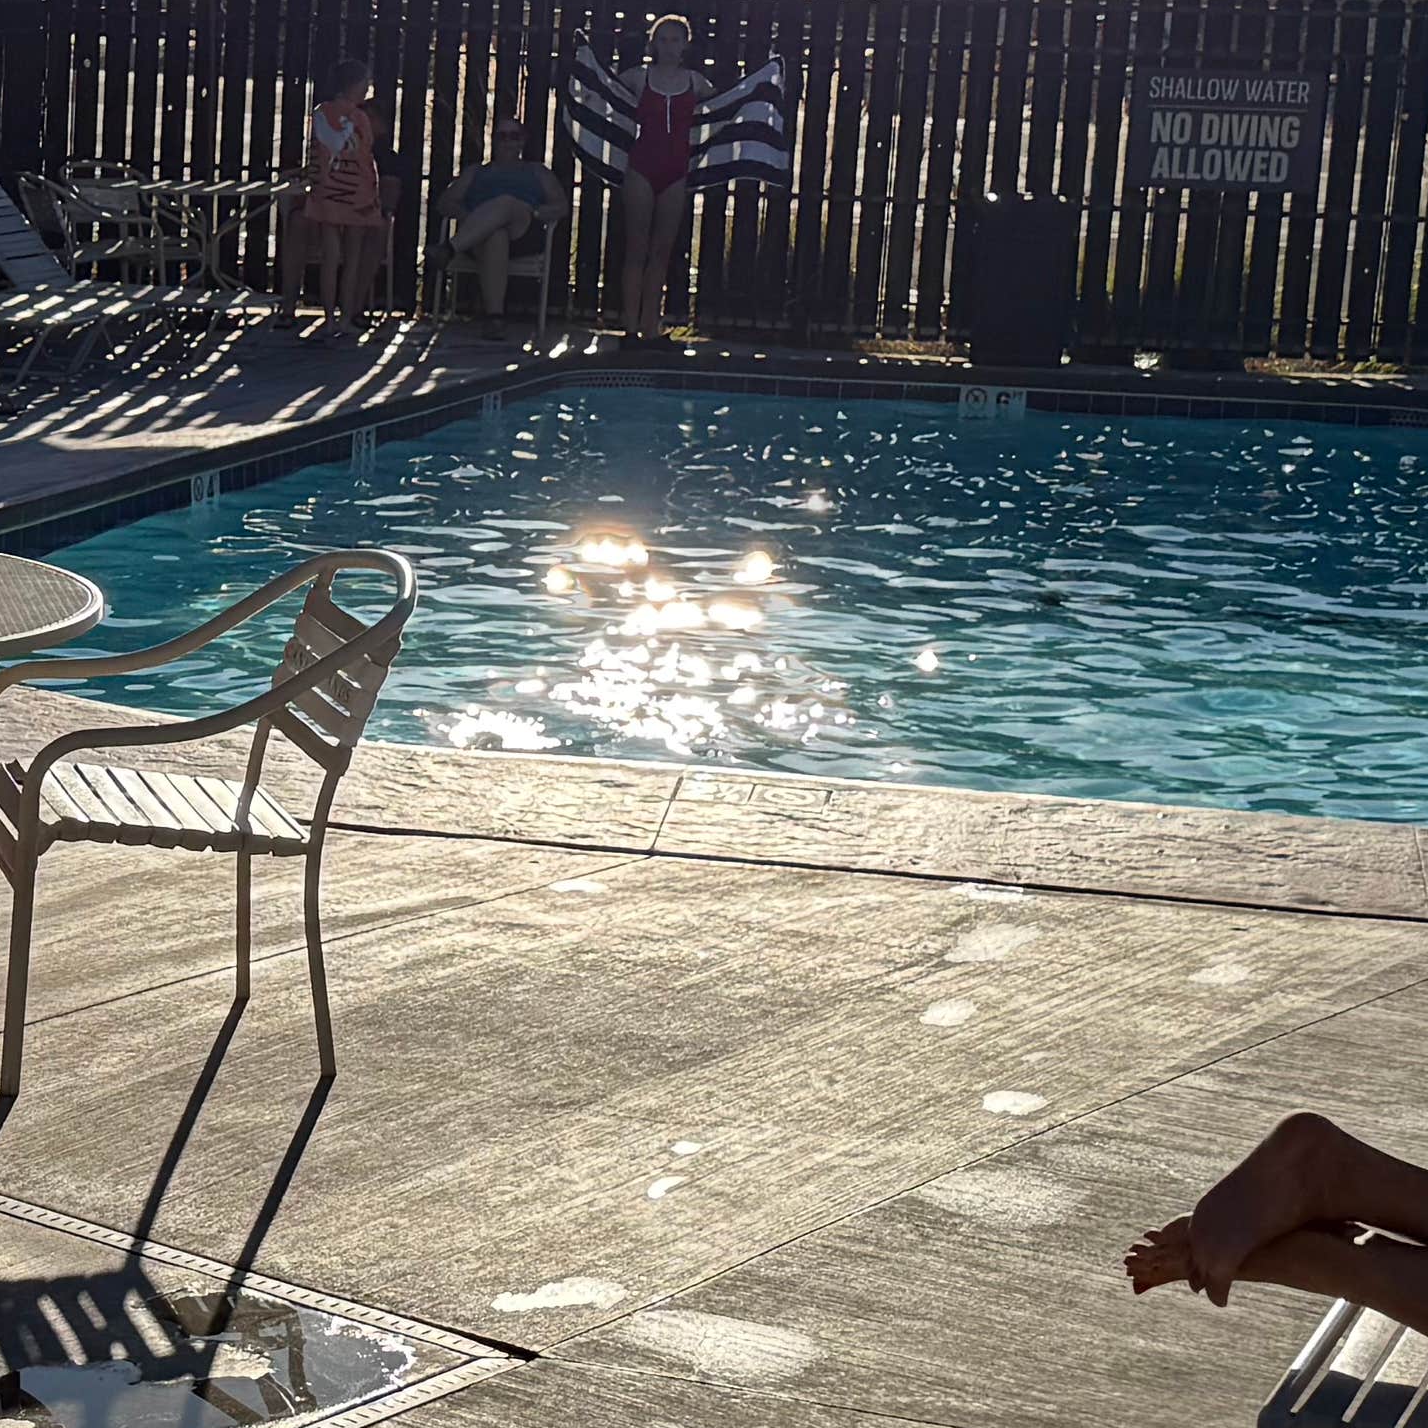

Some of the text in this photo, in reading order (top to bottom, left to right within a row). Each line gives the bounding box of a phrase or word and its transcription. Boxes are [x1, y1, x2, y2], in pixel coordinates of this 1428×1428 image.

[1149, 75, 1310, 104] SHALLOW WATER
[1150, 111, 1301, 149] NO DIVING
[1150, 146, 1290, 184] ALLOWED
